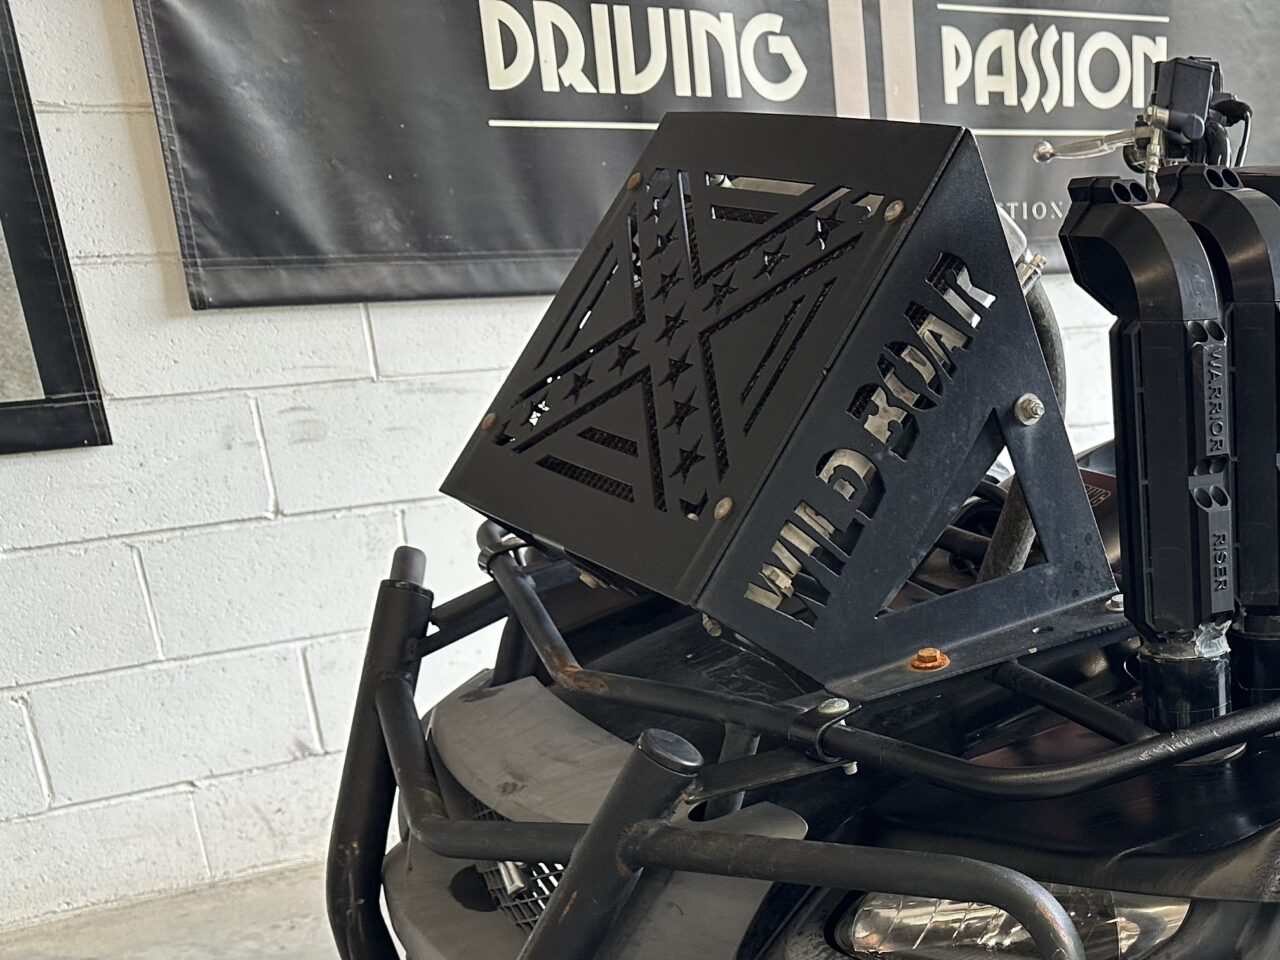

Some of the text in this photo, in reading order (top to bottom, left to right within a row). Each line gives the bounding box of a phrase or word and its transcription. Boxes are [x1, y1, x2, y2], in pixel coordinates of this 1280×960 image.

[479, 0, 808, 102] DRIVING
[941, 23, 1168, 113] PASSION
[997, 201, 1063, 220] TION
[744, 252, 997, 629] WILD BOAR
[1207, 350, 1228, 592] WARRIOR RISER
